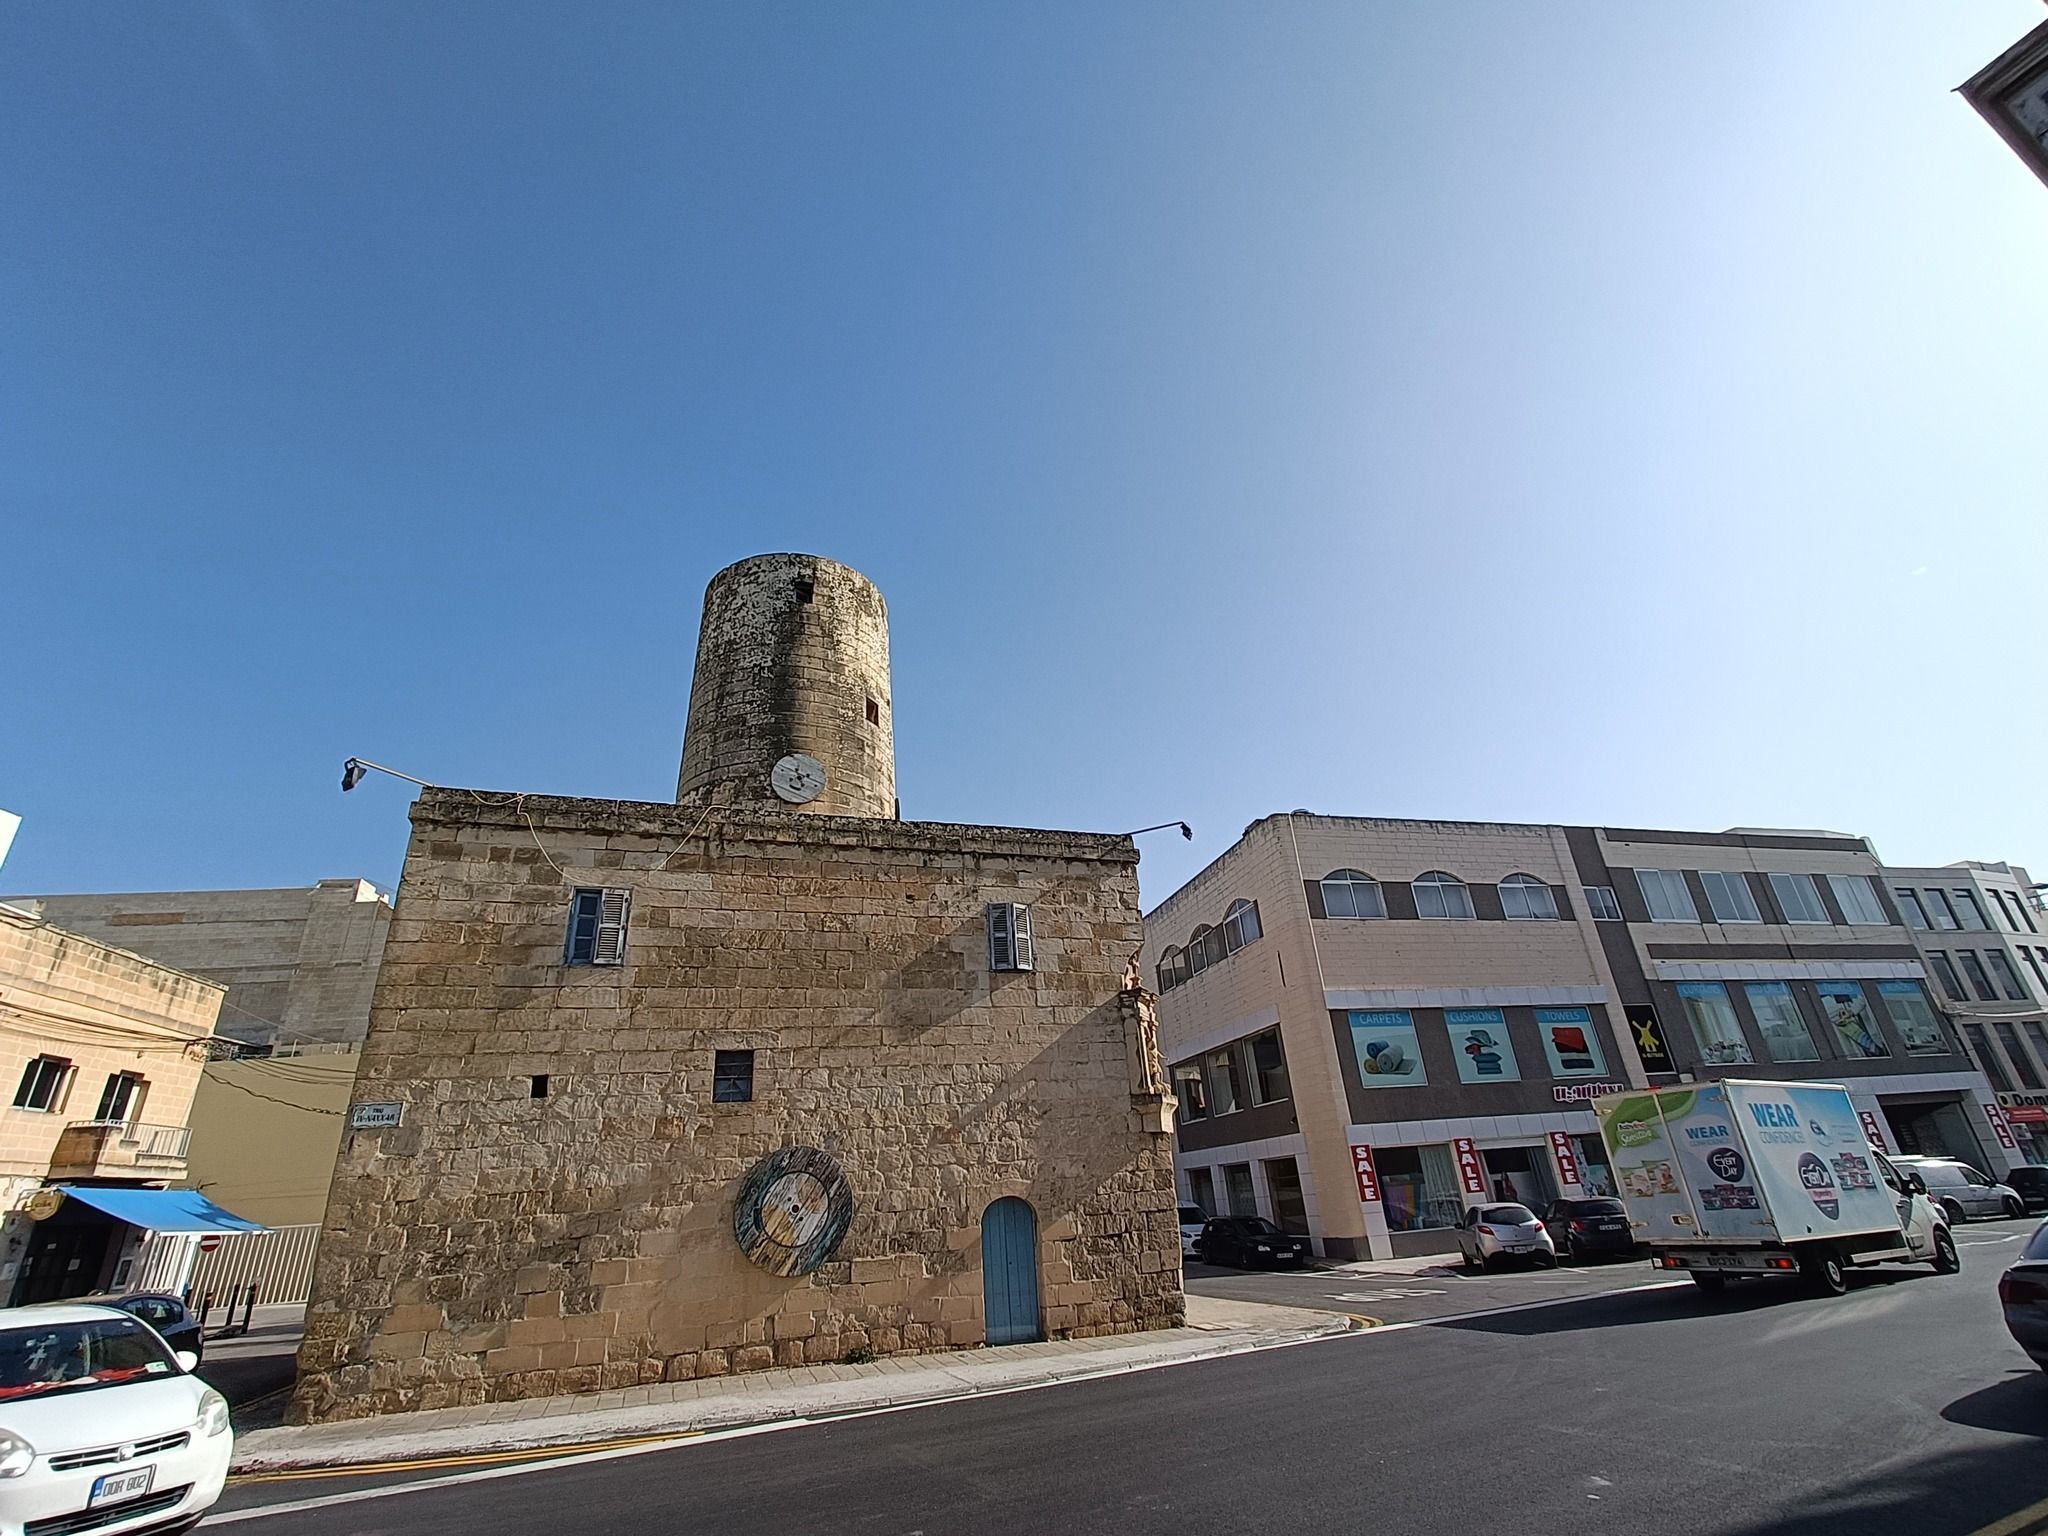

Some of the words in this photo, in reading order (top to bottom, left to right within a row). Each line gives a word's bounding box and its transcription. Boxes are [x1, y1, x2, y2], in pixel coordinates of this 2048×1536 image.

[1359, 1013, 1402, 1024] CARPETS
[1451, 1011, 1498, 1022] CUSHIONS
[1544, 1011, 1580, 1021] TOWELS
[2012, 1094, 2048, 1106] Dom
[1747, 1103, 1799, 1127] WEAR
[1685, 1125, 1729, 1139] WEAR
[1986, 1105, 2012, 1147] SALE
[1459, 1140, 1480, 1191] SALE
[1554, 1133, 1576, 1183] SALE
[1356, 1147, 1376, 1200] SALE
